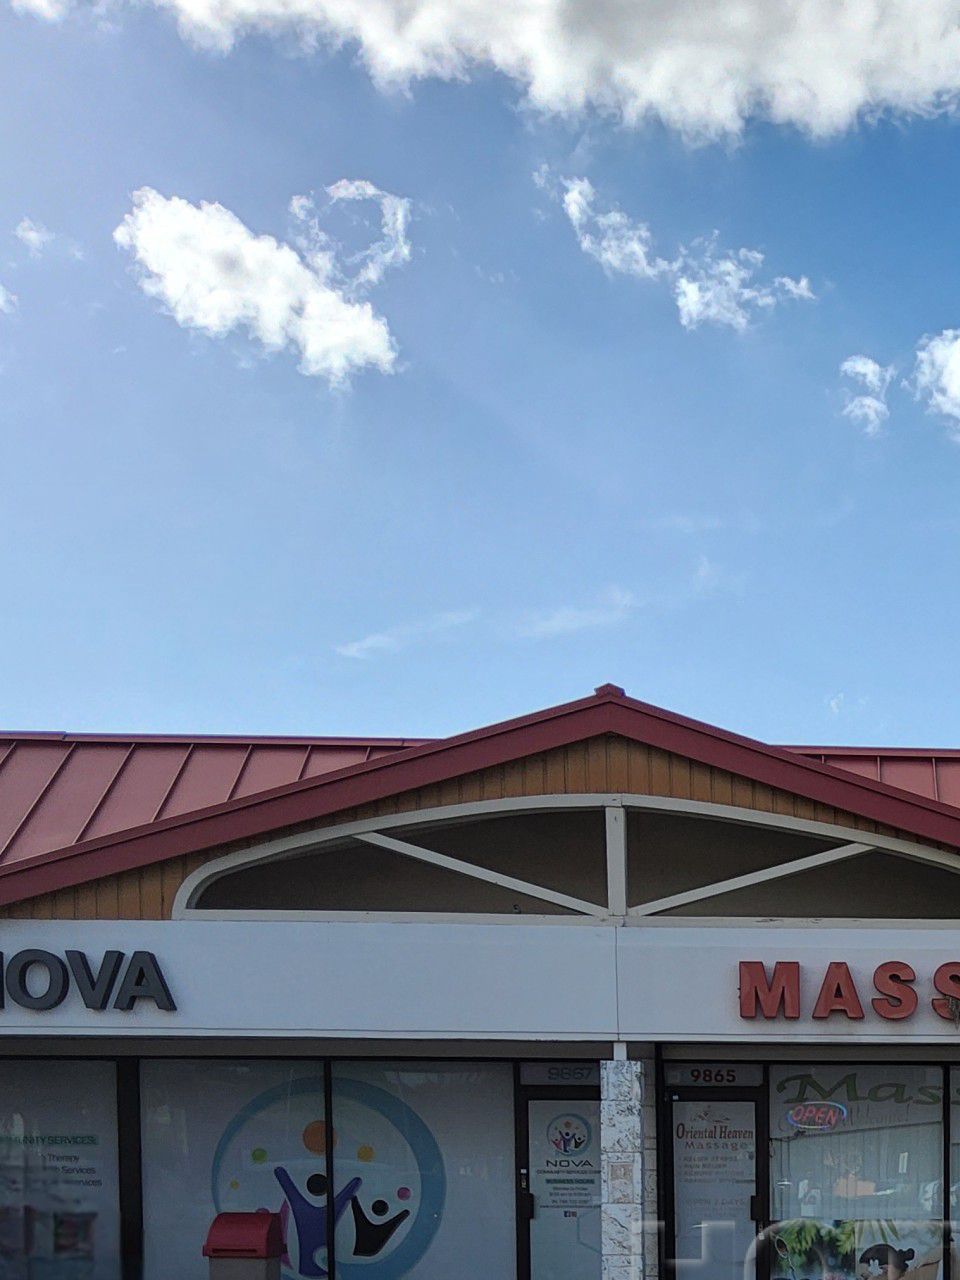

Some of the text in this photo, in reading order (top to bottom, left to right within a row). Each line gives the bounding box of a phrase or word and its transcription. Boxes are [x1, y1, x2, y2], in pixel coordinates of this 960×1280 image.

[0, 949, 178, 1012] OVA
[691, 1068, 737, 1083] 9865
[791, 1103, 839, 1127] OPEN
[677, 1122, 754, 1139] Oriental Heaven
[546, 1159, 594, 1168] NOVA
